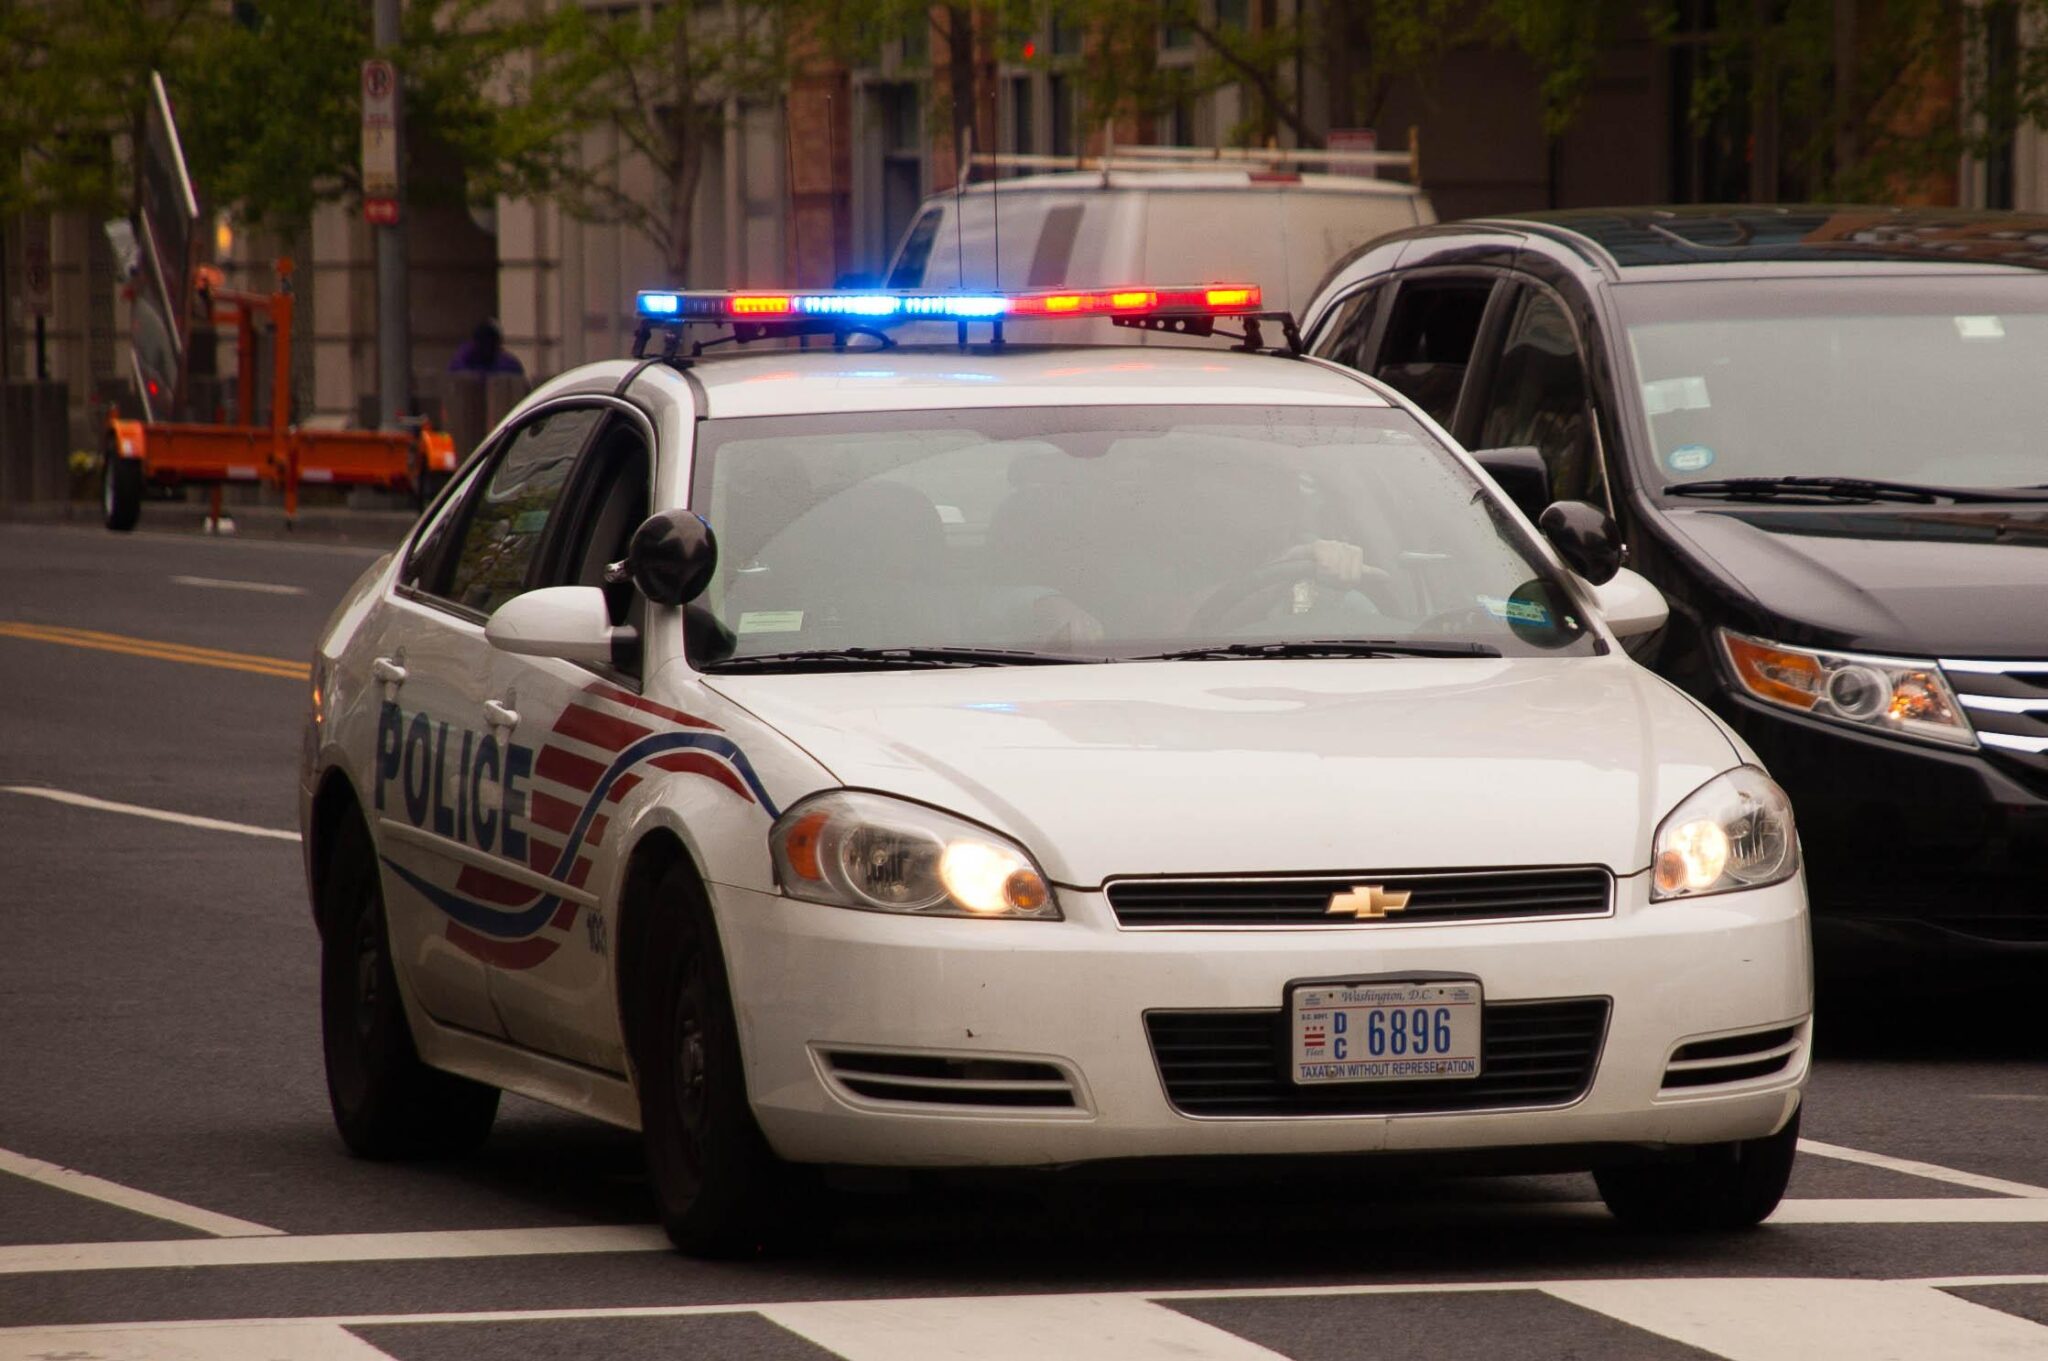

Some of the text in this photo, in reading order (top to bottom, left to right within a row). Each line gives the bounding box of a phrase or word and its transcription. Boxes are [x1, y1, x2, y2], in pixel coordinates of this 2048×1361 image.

[374, 700, 534, 863] POLICE
[1341, 989, 1433, 1006] Washington, D.C.
[1368, 1008, 1451, 1056] 6896
[1300, 1064, 1345, 1078] TAXATON
[1347, 1062, 1389, 1077] WITHOUT
